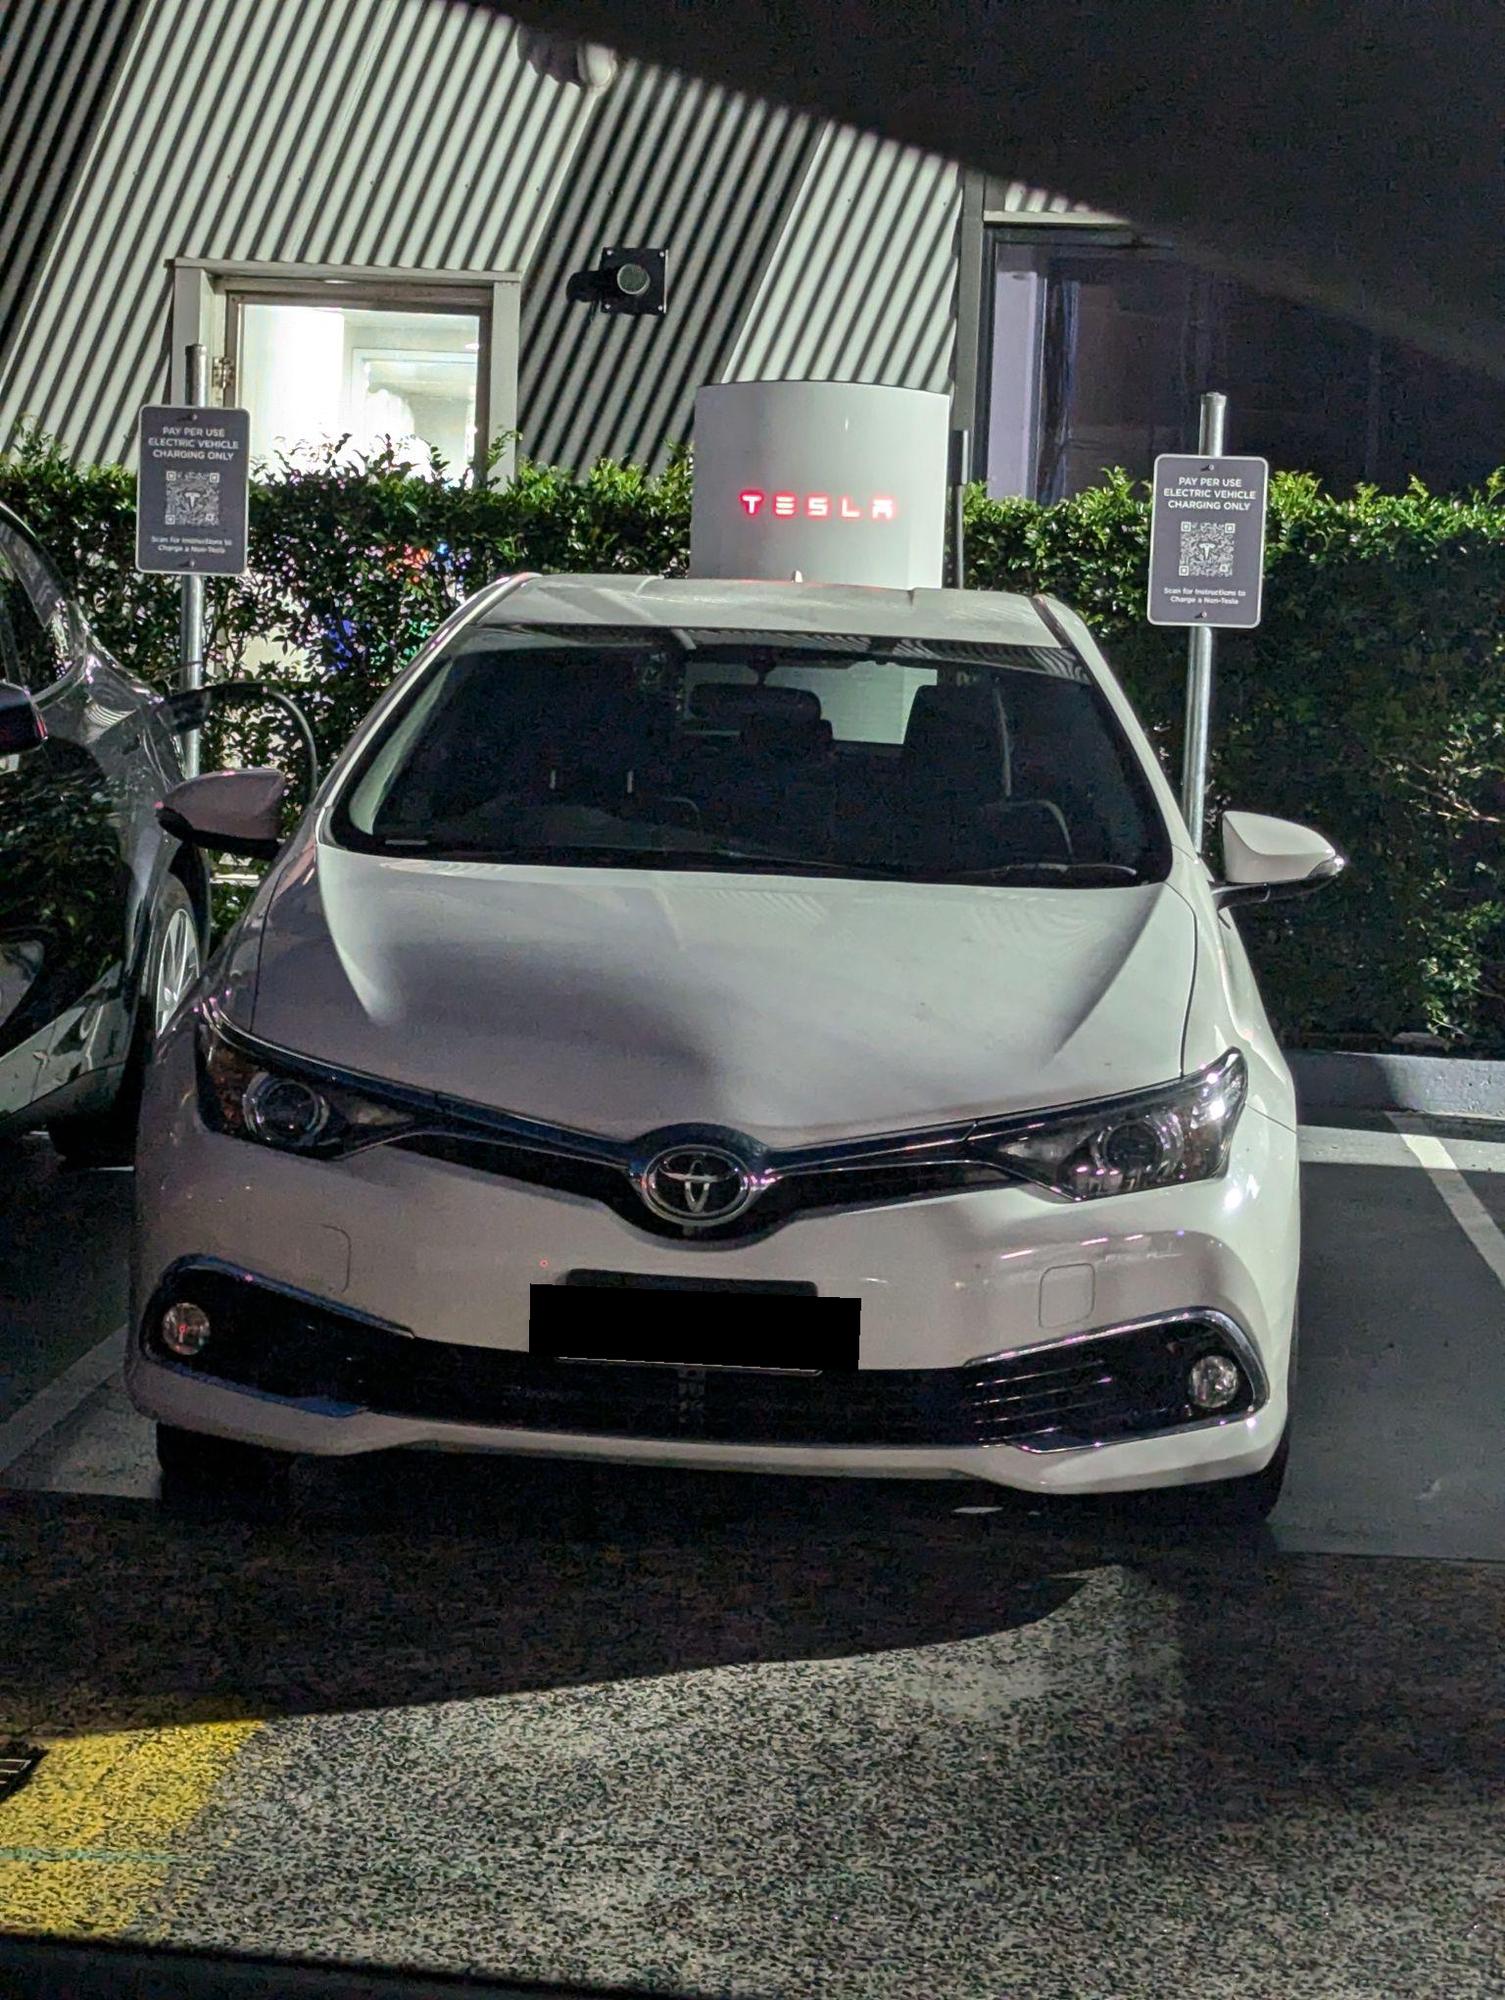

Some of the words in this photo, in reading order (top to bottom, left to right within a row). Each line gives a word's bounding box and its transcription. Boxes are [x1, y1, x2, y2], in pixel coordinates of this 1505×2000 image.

[163, 426, 181, 435] PAY
[184, 427, 203, 436] PER
[206, 428, 225, 438] USE
[148, 438, 195, 448] ELECTRIC
[198, 440, 239, 449] VEHICLE
[152, 449, 205, 460] CHARGING
[207, 451, 234, 460] ONLY
[1178, 477, 1198, 486] PAY
[1200, 477, 1220, 486] PER
[1222, 478, 1242, 487] USE
[1163, 488, 1211, 498] ELECTRIC
[1213, 490, 1257, 499] VEHICLE
[741, 493, 894, 519] TESLA
[1168, 500, 1221, 510] CHARGING
[1223, 502, 1251, 511] ONLY
[1170, 595, 1196, 604] Charge
